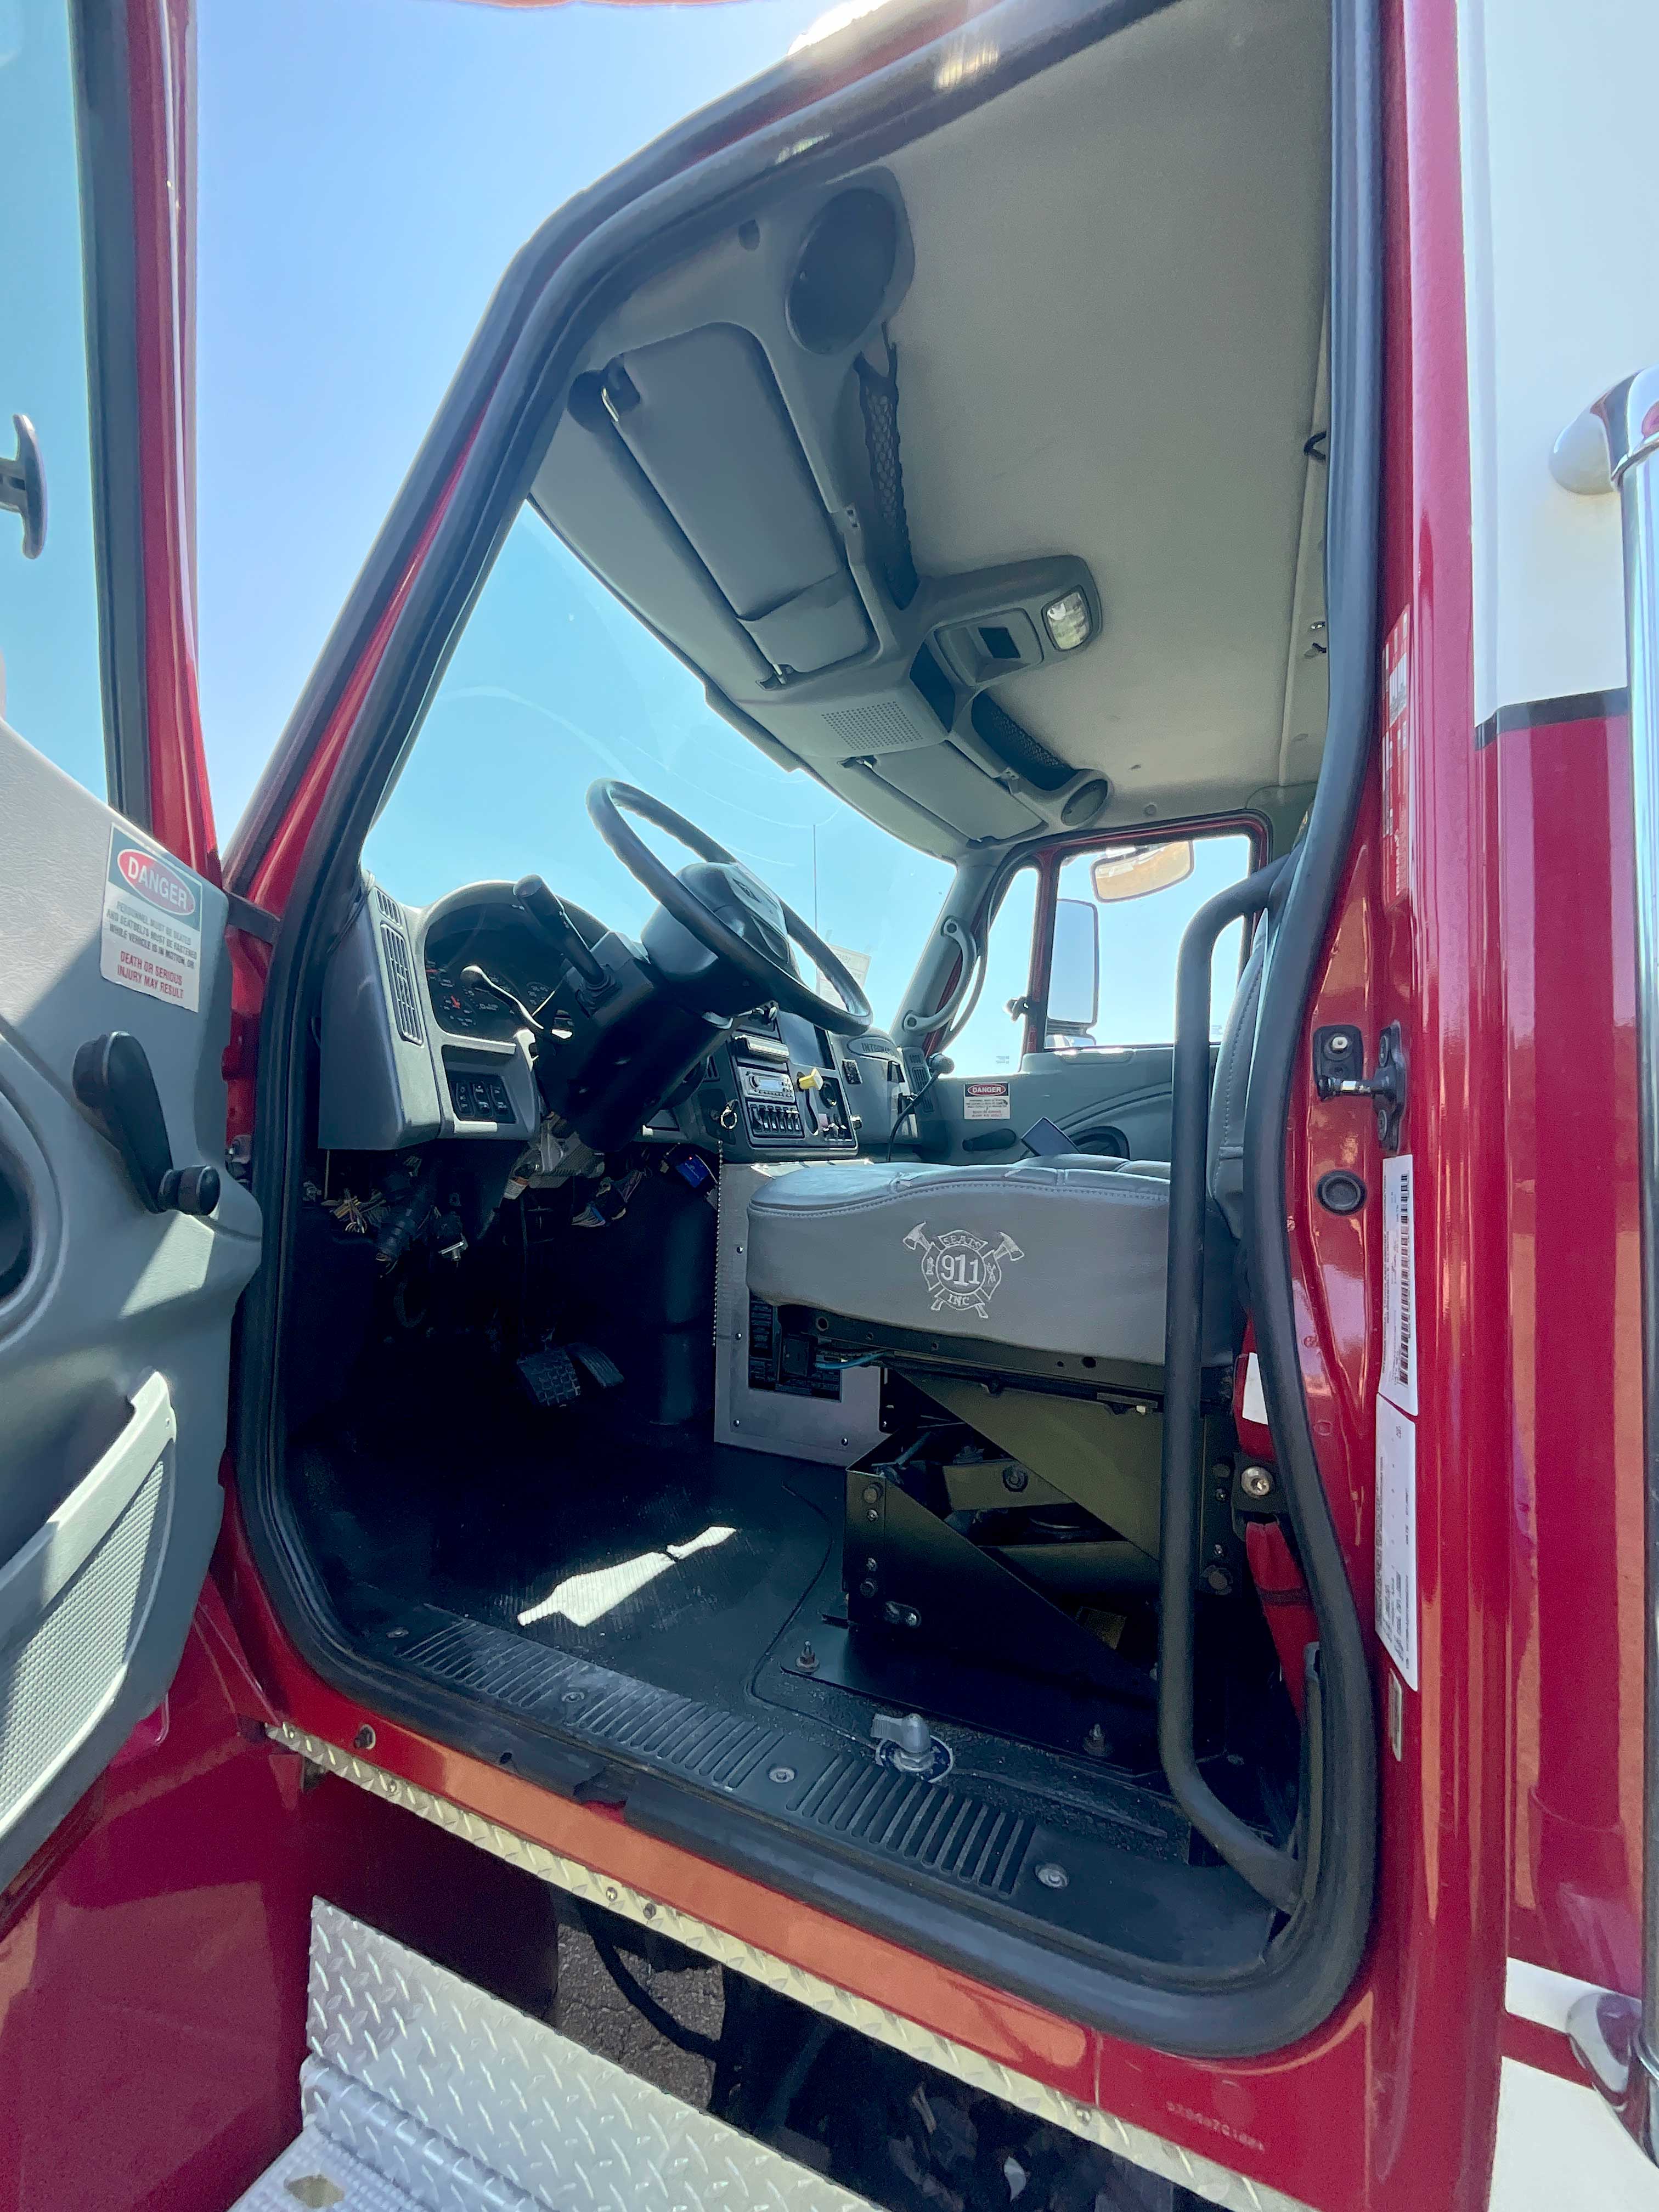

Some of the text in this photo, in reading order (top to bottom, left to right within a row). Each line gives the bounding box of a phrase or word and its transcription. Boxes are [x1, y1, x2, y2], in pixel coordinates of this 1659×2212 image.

[128, 856, 187, 910] DANGER
[110, 923, 128, 939] WHILE
[117, 964, 184, 998] INJURY MAY RESULT
[120, 951, 183, 985] DEATH OR SERIOUS
[943, 1235, 981, 1250] SEATS
[940, 1254, 981, 1286] 911
[947, 1294, 970, 1306] INC
